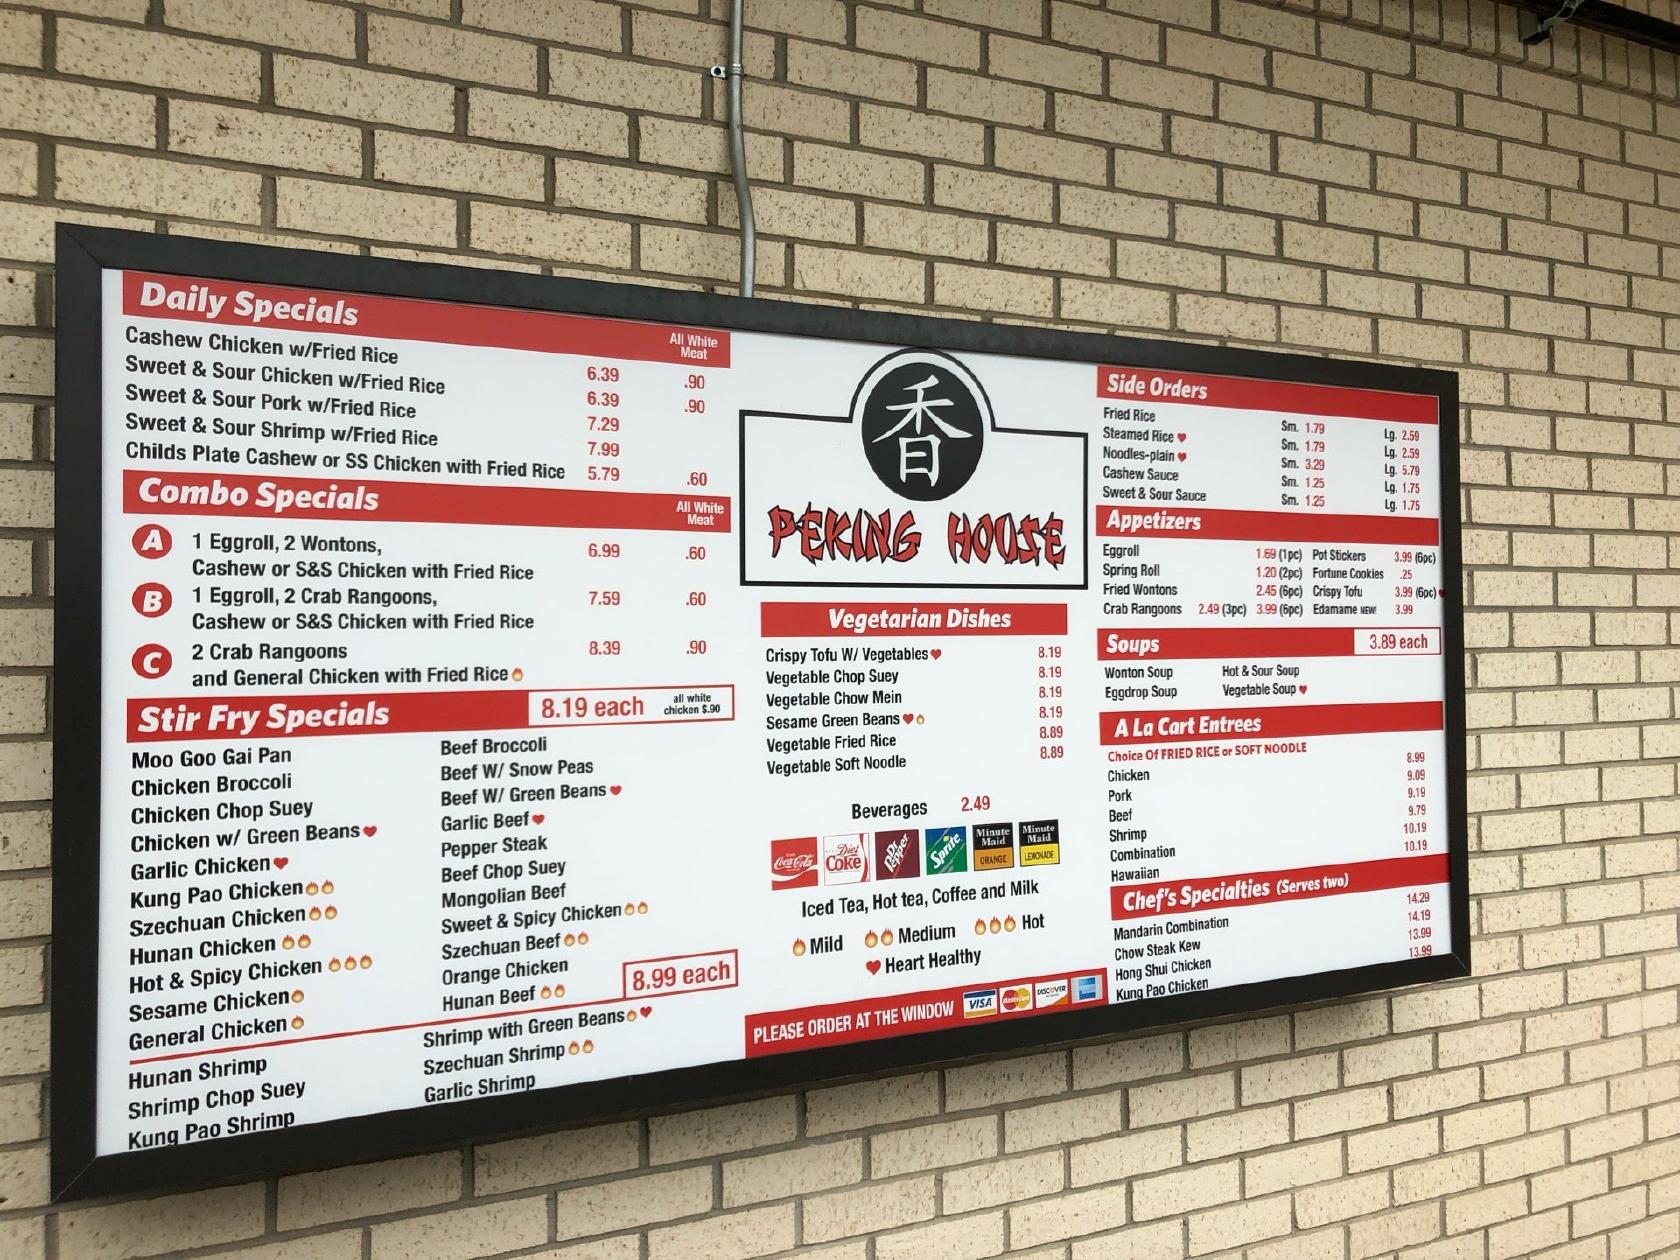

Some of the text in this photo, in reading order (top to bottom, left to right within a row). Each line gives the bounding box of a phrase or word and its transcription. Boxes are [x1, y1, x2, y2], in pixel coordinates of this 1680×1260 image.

[140, 282, 358, 326] Daily Specials
[126, 326, 398, 364] Cashew Chicken w/Fried Rice
[669, 332, 718, 348] All White
[681, 346, 708, 360] Meat
[587, 366, 619, 382] 6.39
[684, 374, 705, 389] .90
[1107, 373, 1207, 399] Side Orders
[1104, 407, 1156, 422] Fried Rice
[871, 374, 974, 487] 香
[1281, 420, 1325, 435] Sm. 1.79
[1384, 428, 1420, 442] Lg. 2.59
[1103, 446, 1175, 464] Noodles-plain
[588, 466, 620, 481] 5.79
[687, 472, 707, 486] .60
[139, 477, 379, 513] Combo Specials
[1106, 509, 1201, 533] Appetizers
[141, 529, 163, 551] A
[193, 533, 381, 556] 1 Eggroll, 2 Wontons,
[767, 501, 1066, 571] PEKING HOUSE
[588, 543, 620, 558] 6.99
[1312, 549, 1366, 562] Pot Stickers
[1103, 563, 1160, 578] Spring Roll
[1312, 567, 1384, 579] Fortune Cookies
[1256, 584, 1303, 599] 2.45 (6pc)
[143, 591, 162, 612] B
[1103, 602, 1182, 618] Crab Rangoons
[1313, 603, 1358, 615] Edamame
[829, 608, 1011, 633] Vegetarian Dishes
[589, 640, 620, 655] 8.39
[1106, 634, 1159, 656] Soups
[1370, 633, 1428, 650] 3.89 each
[192, 643, 347, 662] 2 Crab Rangoons
[766, 647, 928, 665] Crispy Tofu W/ Vegetables
[1038, 646, 1061, 658] 8.19
[143, 652, 162, 674] C
[1222, 664, 1300, 678] Hot & Sour Soup
[542, 696, 644, 718] 8.19 each
[673, 693, 711, 703] all white
[138, 701, 389, 735] Stir Fry Specials
[664, 704, 720, 715] chicken $.90
[1114, 716, 1261, 738] A La Cart Entrees
[441, 736, 547, 756] Beef Broccoli
[1040, 745, 1064, 759] 8.89
[1108, 742, 1307, 762] Choice Of FRIED RICE or SOFT NOODLE
[132, 747, 291, 769] Moo Goo Gai Pan
[1407, 752, 1425, 763] 8.99
[441, 760, 593, 781] Beef W/ Snow Peas
[852, 802, 927, 819] Beverages
[961, 795, 990, 812] 2.49
[976, 828, 1011, 837] Minute
[930, 833, 960, 870] Sprite
[981, 838, 1006, 847] Maid
[1404, 839, 1427, 851] 10.19
[825, 854, 861, 871] Coke
[980, 854, 1007, 865] ORANGE
[1024, 850, 1054, 861] LEMONADE
[1110, 845, 1175, 862] Combination
[442, 882, 566, 909] Mongolian Beef
[802, 879, 1039, 917] Iced Tea, Hot tea, Coffee and Milk
[1123, 873, 1349, 912] Chef's Specialties (Serves two)
[1407, 892, 1430, 904] 14.29
[1022, 913, 1045, 930] Hot
[899, 925, 956, 944] Medium
[810, 935, 843, 955] Mild
[1115, 940, 1201, 961] Chow Steak Kew
[885, 948, 981, 974] Heart Healthy
[130, 960, 322, 994] Hot & Spicy Chicken
[633, 960, 730, 991] 8.99 each
[969, 998, 992, 1009] VISA
[754, 1000, 954, 1044] PLEASE ORDER AT THE WINDOW
[424, 1044, 565, 1075] Szechuan Shrimp
[129, 1059, 267, 1090] Hunan Shrimp
[128, 1081, 305, 1120] Shrimp Chop Suey
